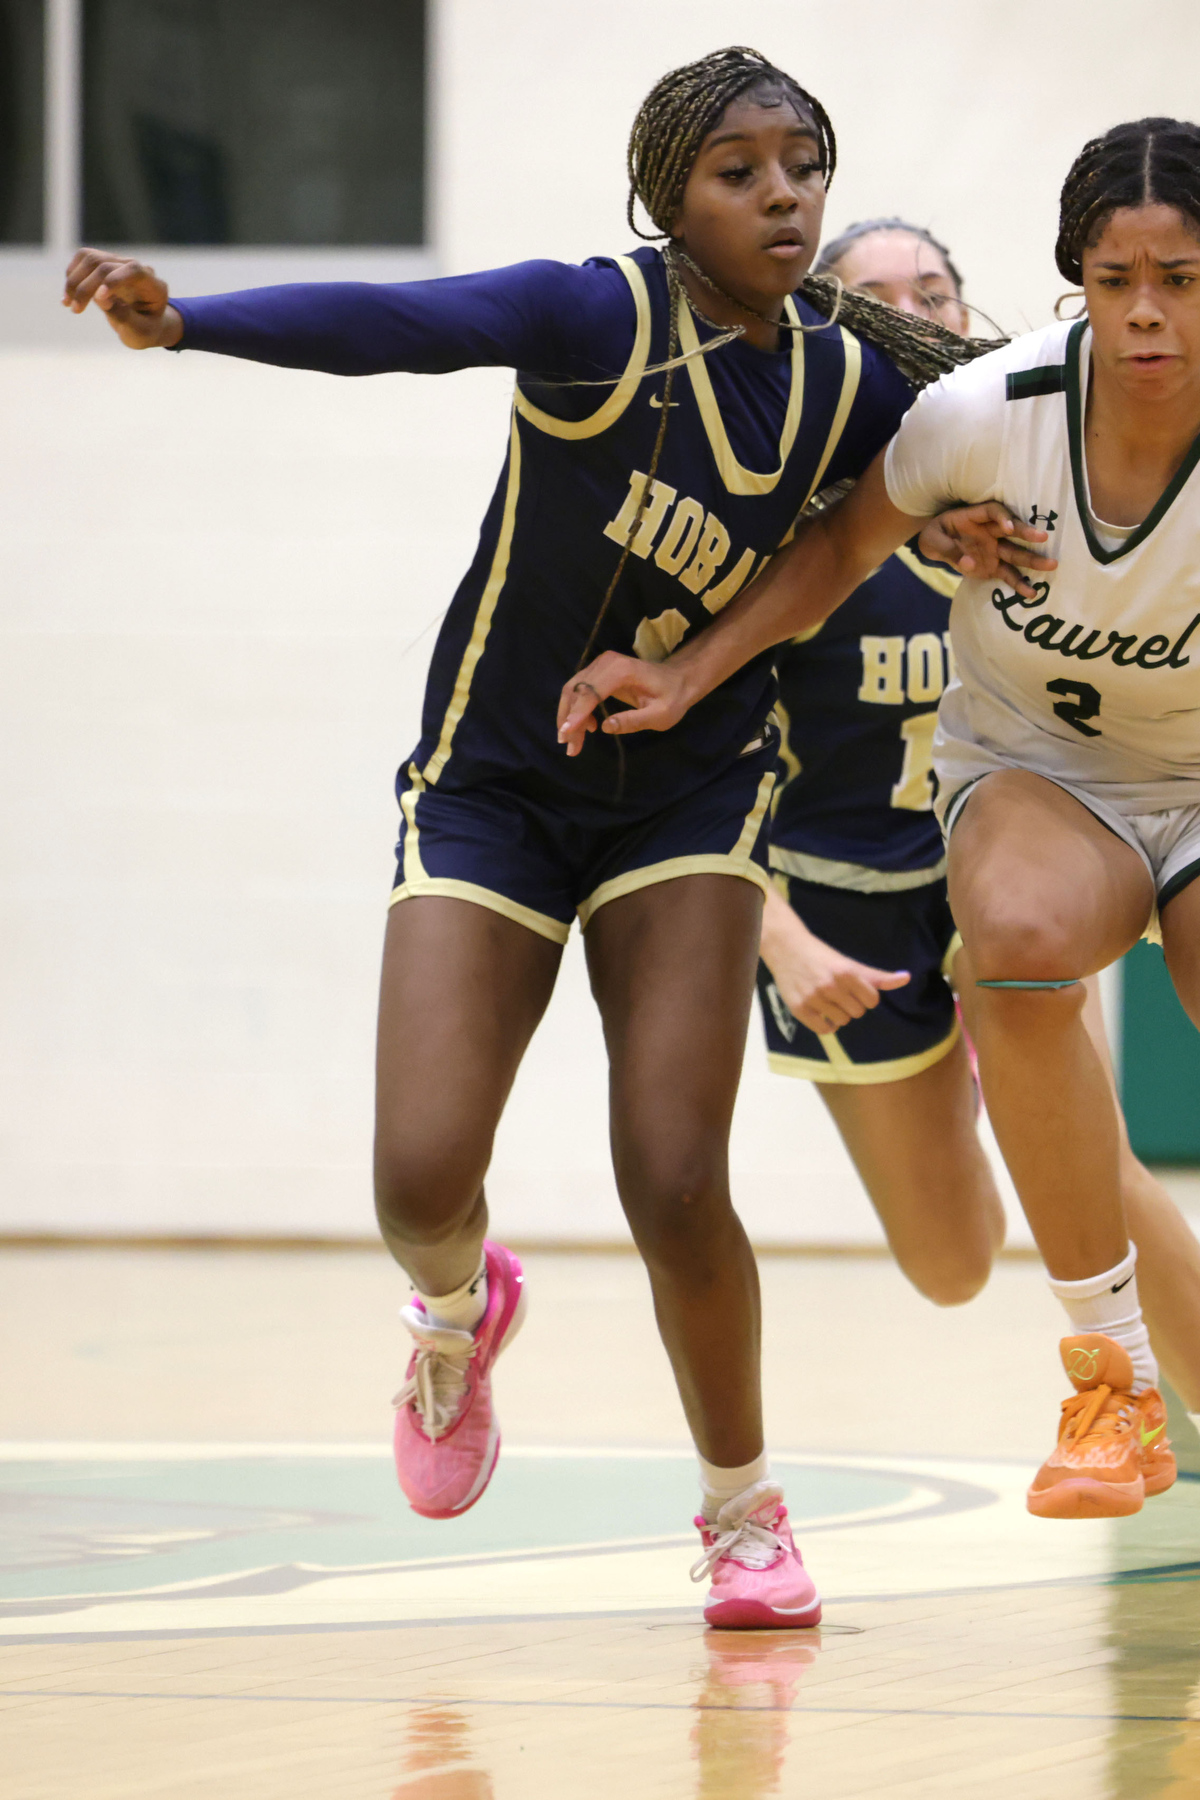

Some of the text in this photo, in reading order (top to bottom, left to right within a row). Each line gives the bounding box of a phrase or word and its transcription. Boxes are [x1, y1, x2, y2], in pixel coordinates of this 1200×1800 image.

[603, 470, 771, 614] HOBA
[857, 631, 957, 705] HO
[1046, 678, 1102, 737] 2
